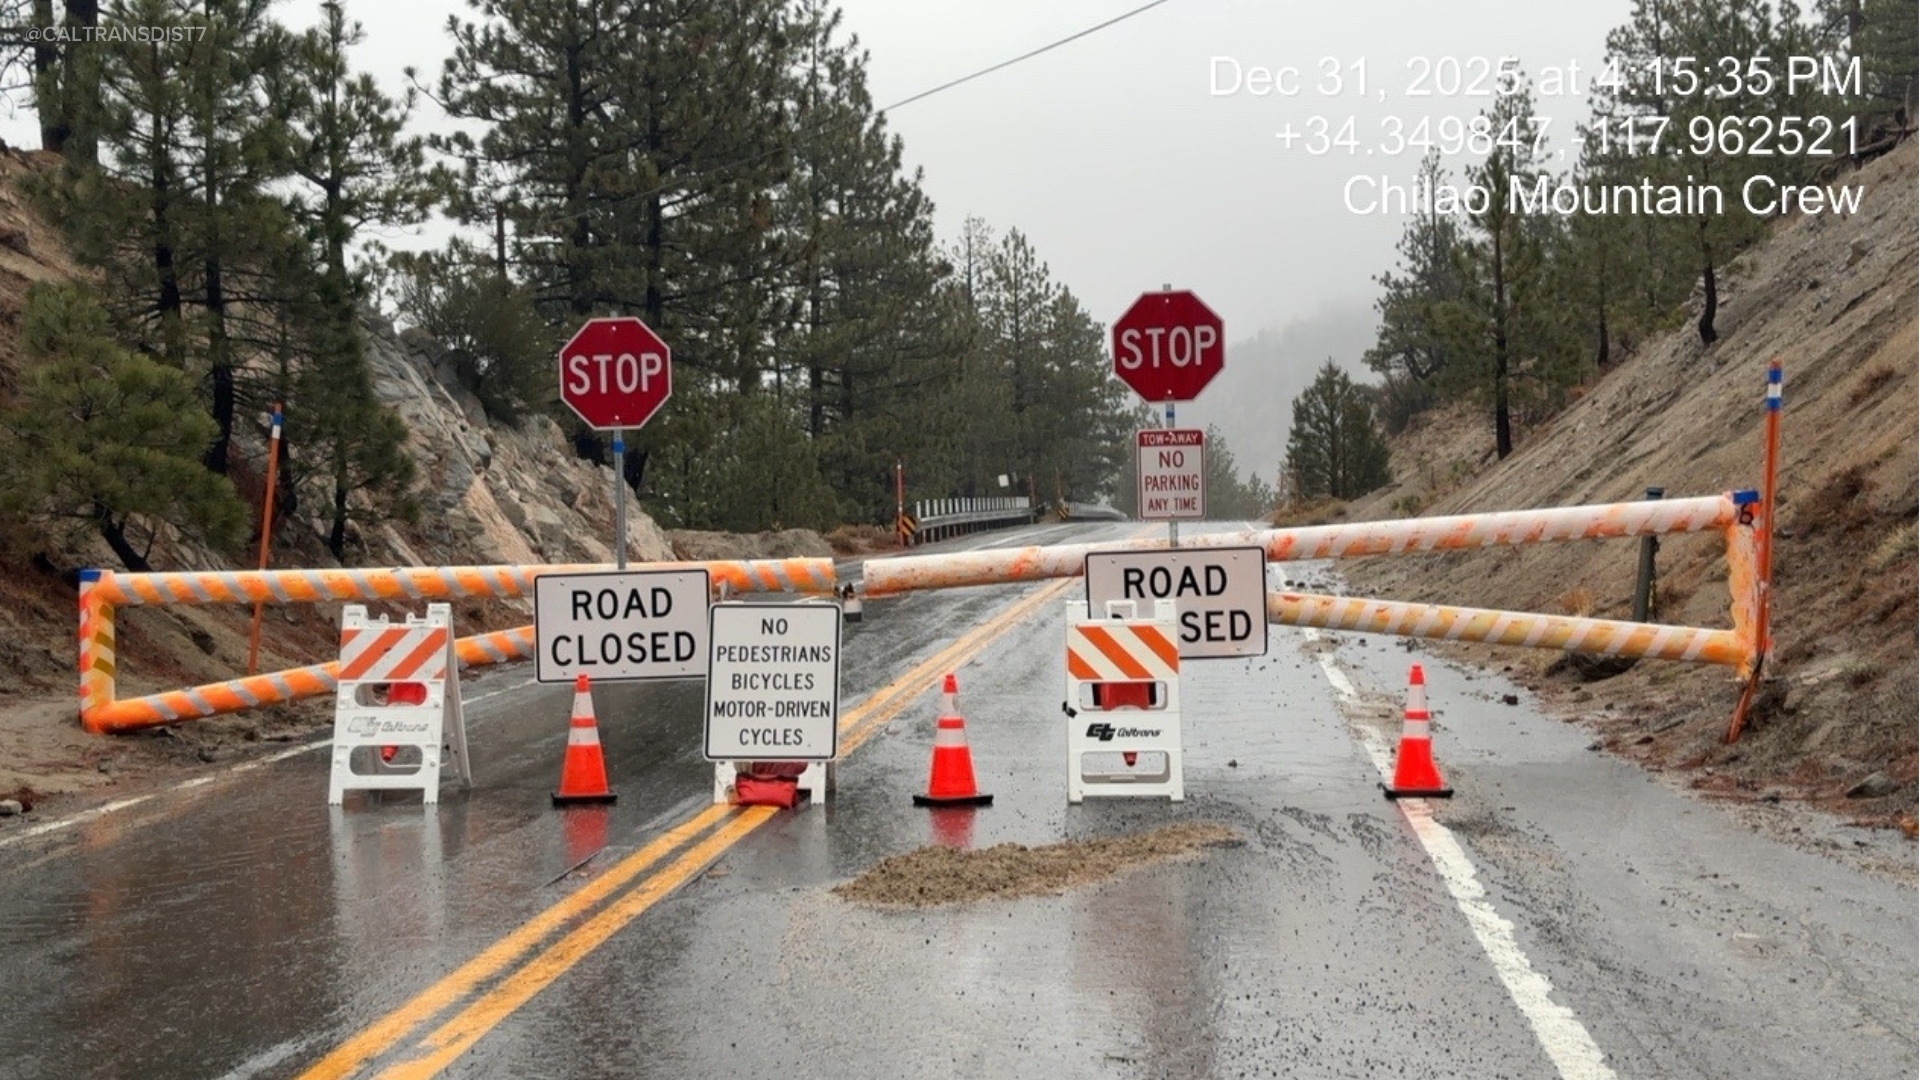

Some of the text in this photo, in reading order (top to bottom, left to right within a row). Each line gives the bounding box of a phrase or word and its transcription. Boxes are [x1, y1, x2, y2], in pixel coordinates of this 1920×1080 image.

[1120, 325, 1217, 370] STOP
[568, 352, 662, 396] STOP
[1142, 433, 1198, 445] TOW-AWAY
[1158, 450, 1185, 468] NO
[1144, 474, 1200, 492] PARKING
[1148, 497, 1198, 512] ANY TIME
[1123, 565, 1228, 599] ROAD
[571, 588, 673, 620] ROAD
[761, 618, 788, 635] NO
[1180, 610, 1252, 643] SED
[551, 632, 696, 667] CLOSED
[716, 645, 832, 662] PEDESTRIANS
[731, 673, 814, 690] BICYCLES
[713, 700, 831, 718] MOTOR-DRIVEN
[739, 728, 804, 746] CYCLES
